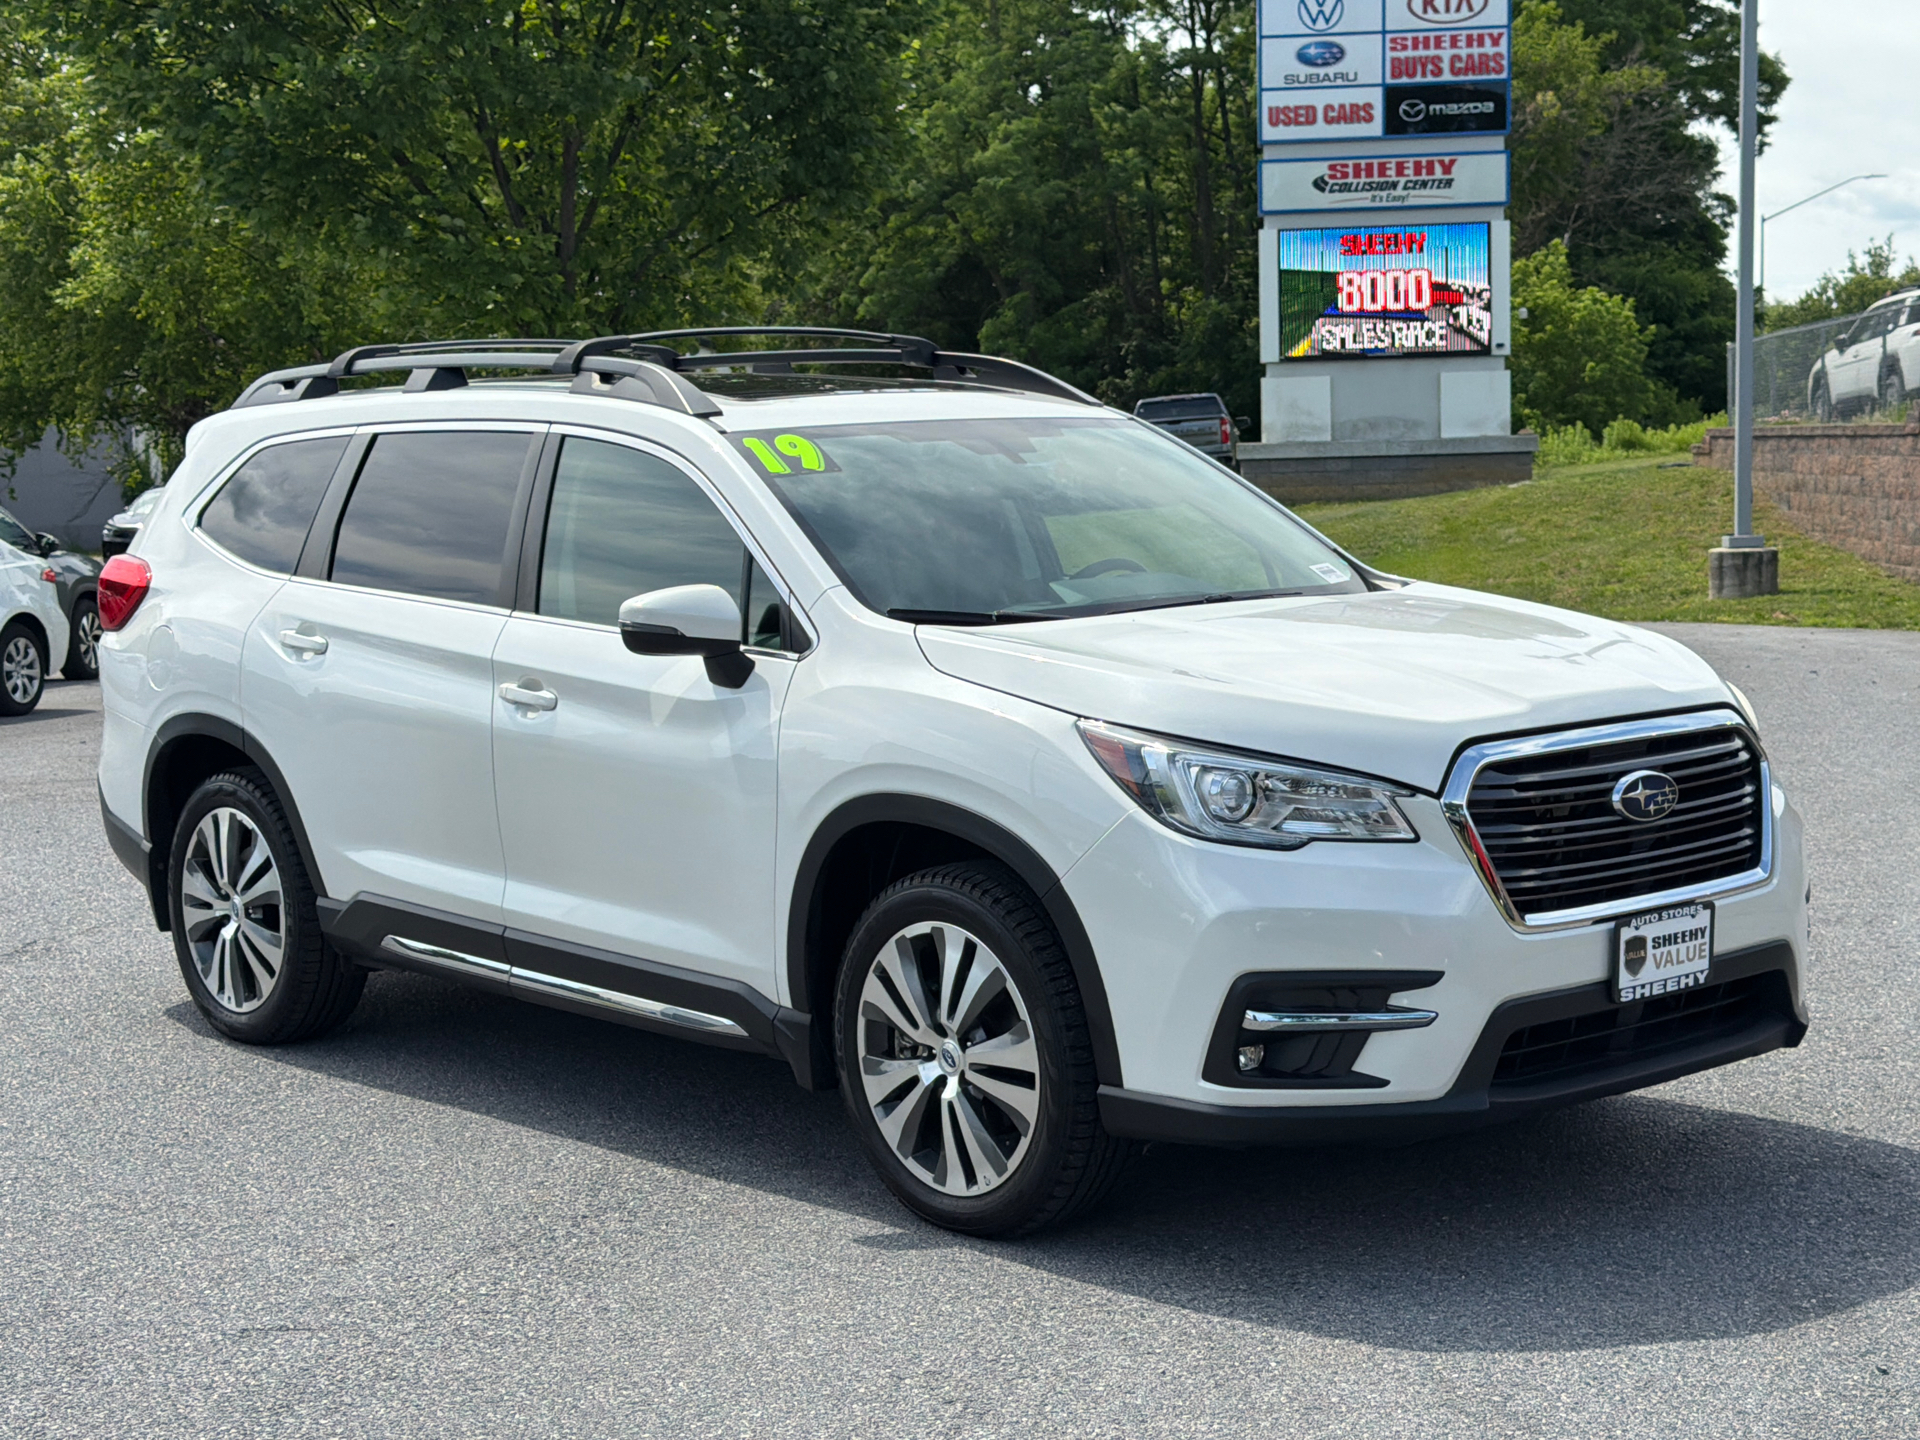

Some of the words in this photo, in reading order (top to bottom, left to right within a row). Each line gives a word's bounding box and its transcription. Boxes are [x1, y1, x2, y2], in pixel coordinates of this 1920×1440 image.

[1389, 32, 1505, 51] SHEEHY
[1390, 54, 1443, 79] BUYS
[1450, 53, 1505, 77] CARS
[1283, 72, 1358, 85] SUBARU
[1268, 105, 1317, 127] USED
[1323, 102, 1374, 126] CARS
[1429, 101, 1495, 116] mazda
[1327, 158, 1458, 180] SHEEHY
[1328, 180, 1399, 194] COLLISION
[1402, 178, 1455, 191] CENTER
[1340, 232, 1427, 256] SHEEHY
[1336, 268, 1432, 313] 8000
[742, 434, 826, 474] 19
[1630, 913, 1659, 928] AUTO
[1661, 904, 1704, 920] STORES
[1651, 925, 1708, 950] SHEEHY
[1652, 941, 1708, 970] VALUE
[1620, 969, 1710, 1003] SHEEHY
